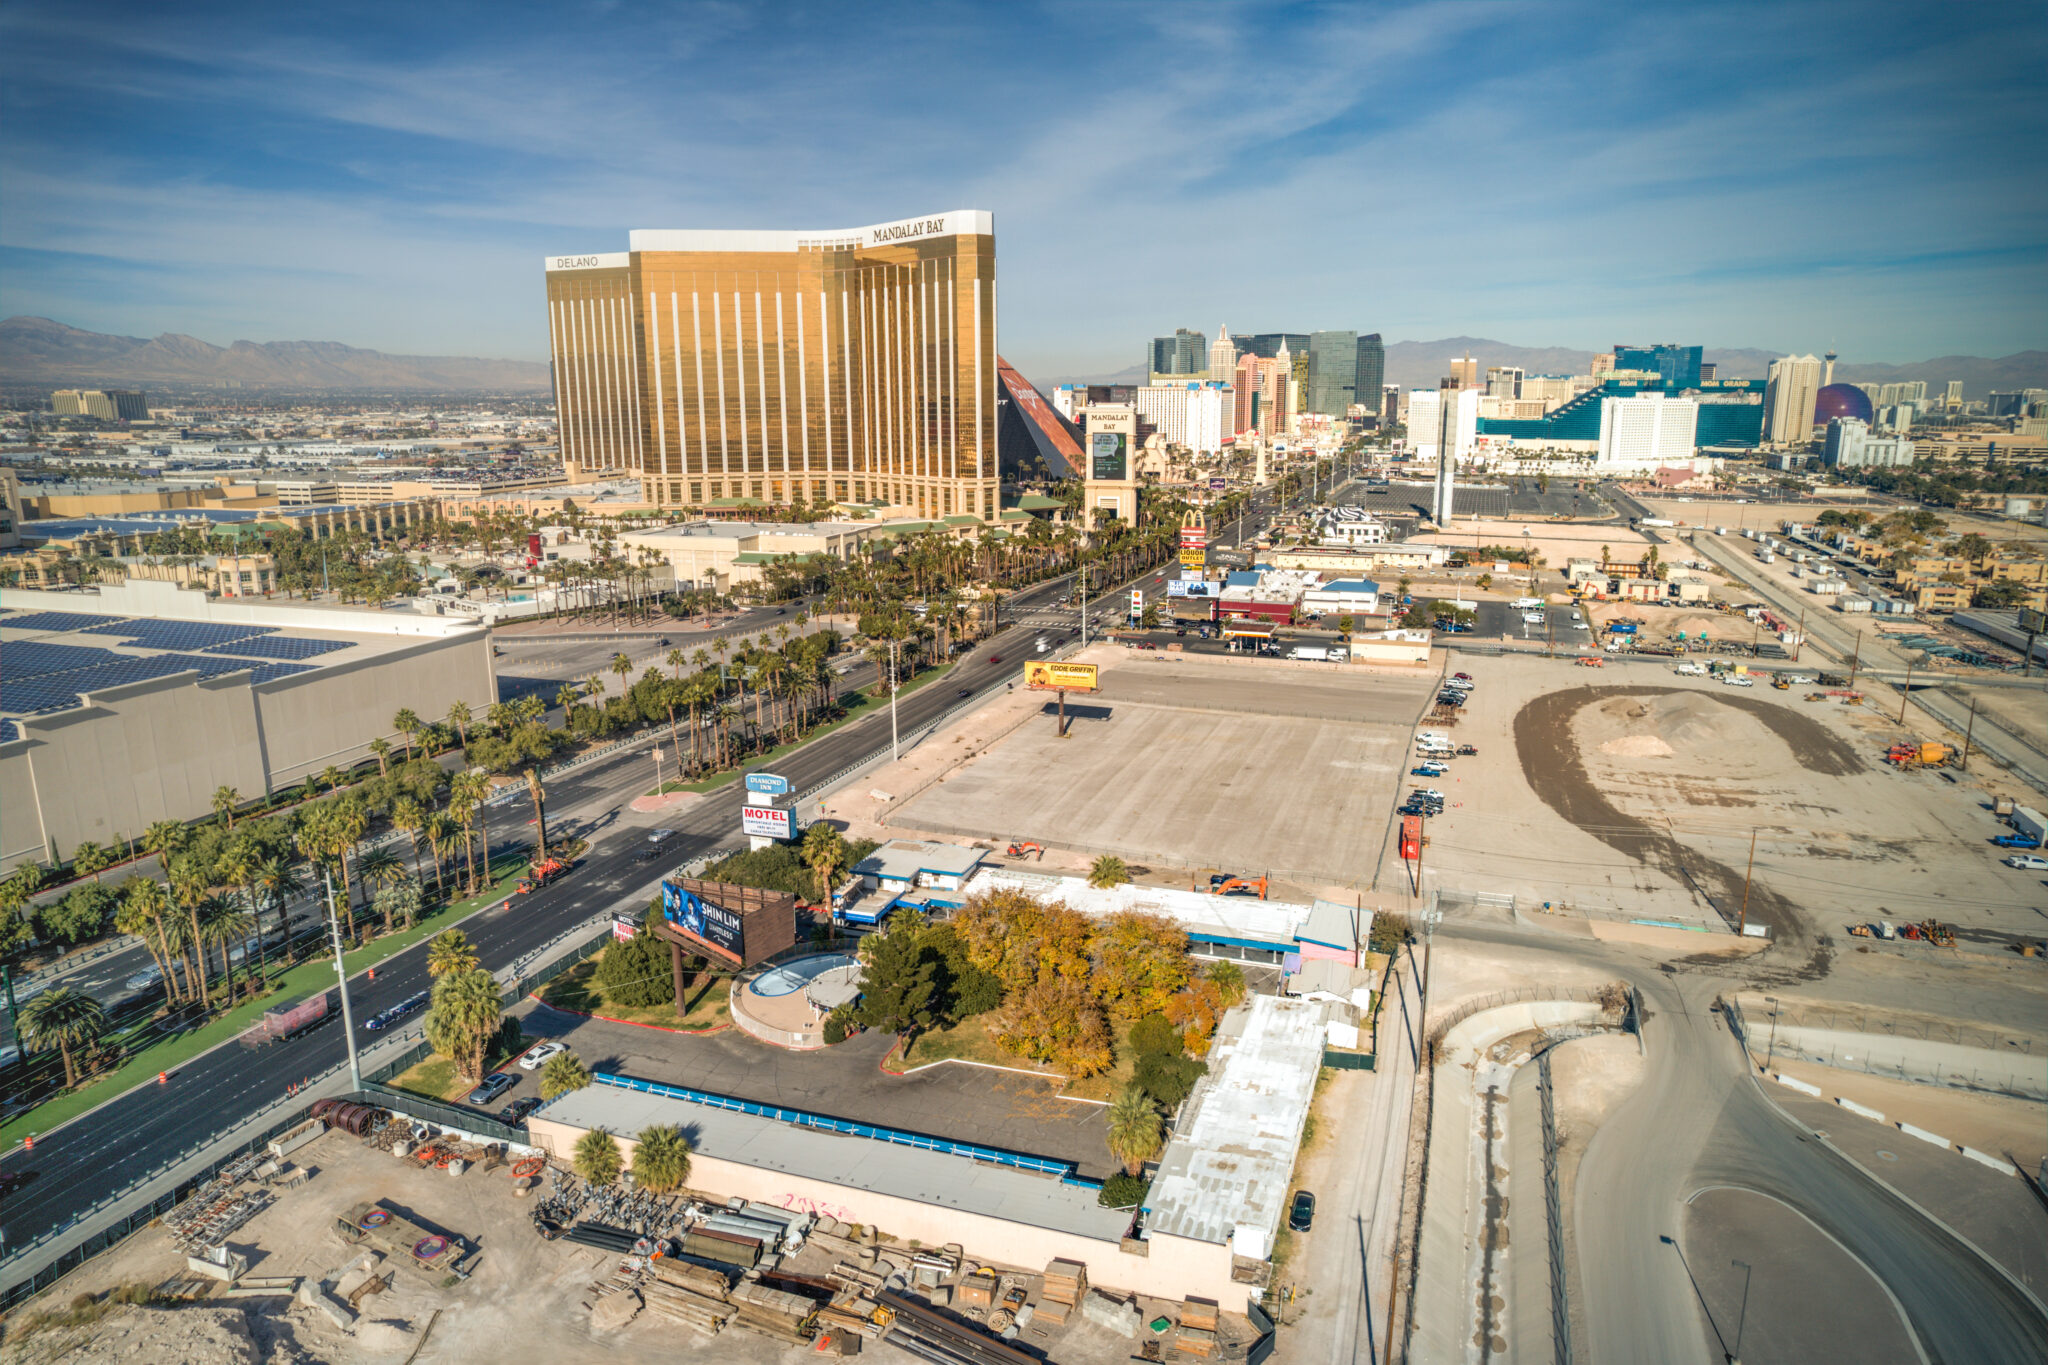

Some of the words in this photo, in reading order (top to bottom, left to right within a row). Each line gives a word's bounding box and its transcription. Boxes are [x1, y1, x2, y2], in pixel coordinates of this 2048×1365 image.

[873, 222, 924, 243] MANDALAY
[926, 218, 945, 234] BAY
[557, 256, 598, 269] DELANO
[1700, 380, 1720, 388] MGM
[1723, 380, 1751, 388] GRAND
[750, 777, 782, 786] DIAMOND
[744, 808, 787, 821] MOTEL
[618, 914, 636, 926] MOTEL
[702, 902, 723, 923] SHIN
[723, 911, 740, 931] LIM
